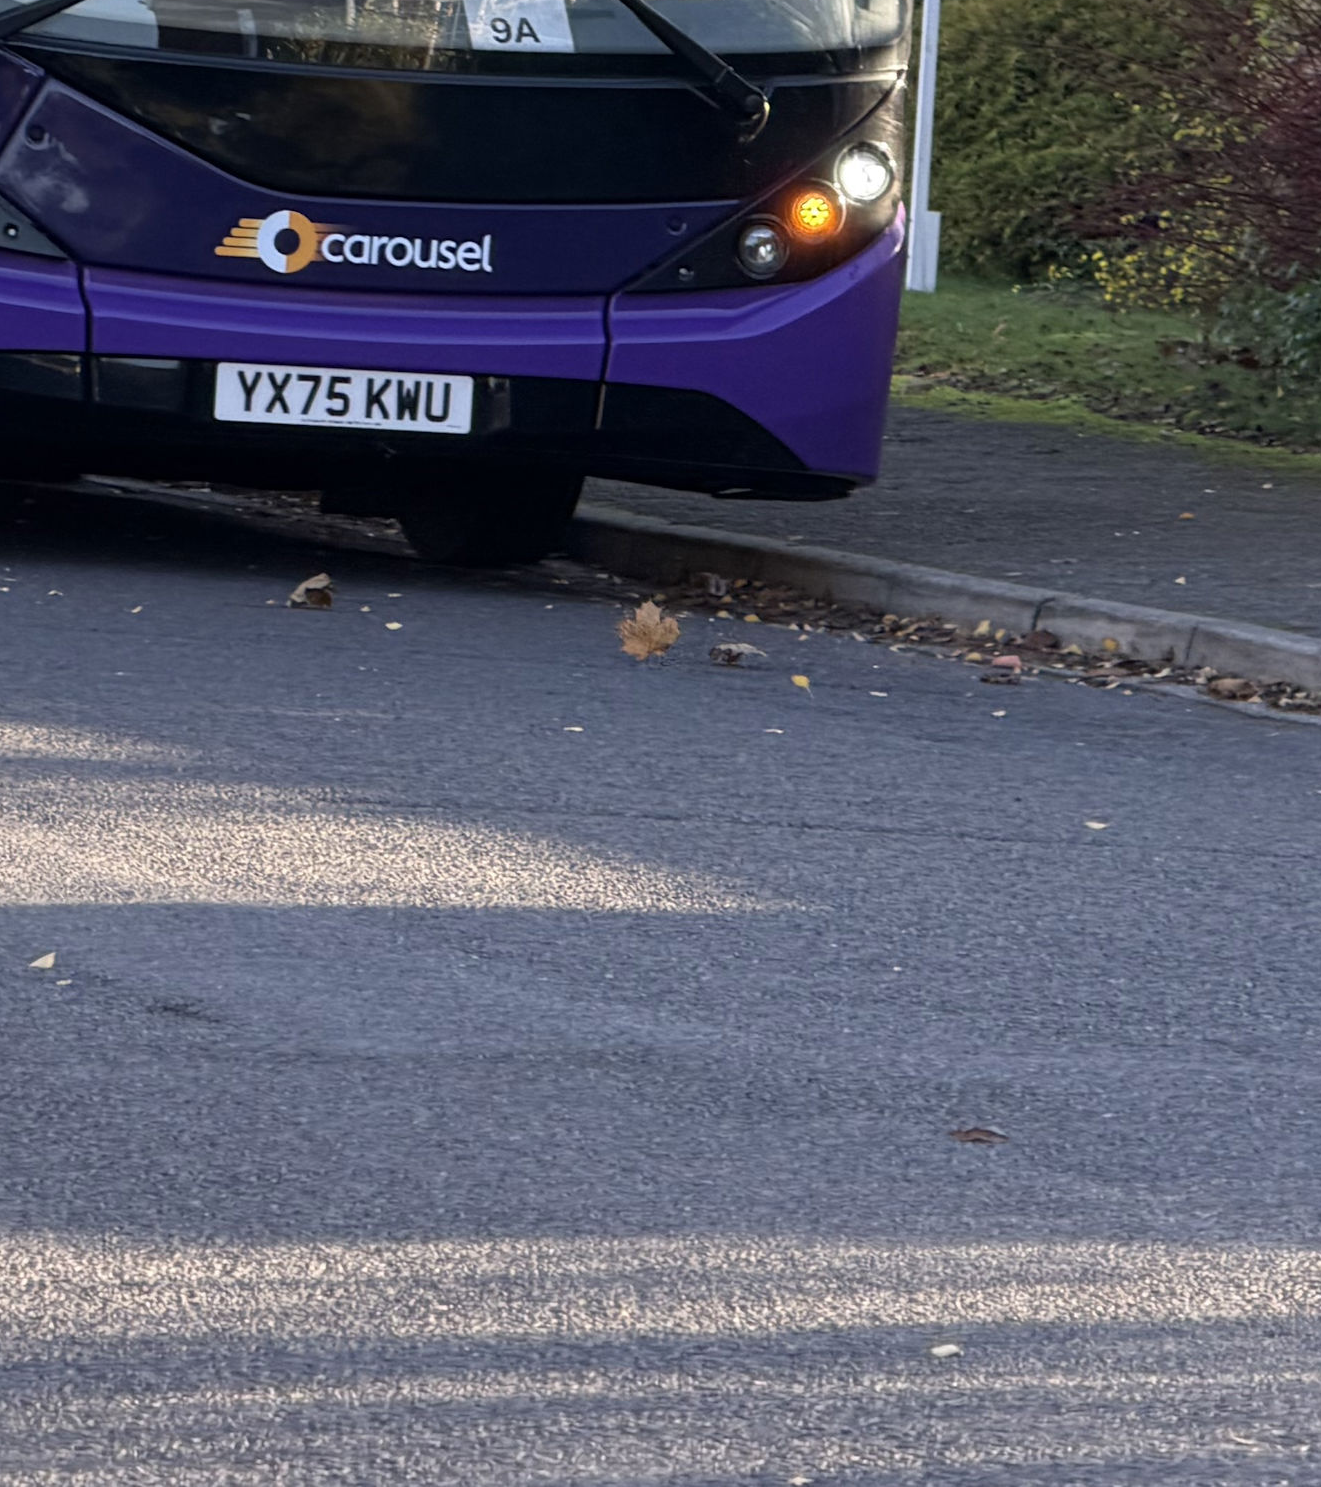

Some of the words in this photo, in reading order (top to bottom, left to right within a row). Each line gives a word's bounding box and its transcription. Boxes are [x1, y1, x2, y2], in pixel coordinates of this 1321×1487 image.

[490, 16, 541, 43] 9A
[320, 232, 493, 273] carousel
[237, 369, 352, 417] YX75
[364, 377, 452, 423] KWU
